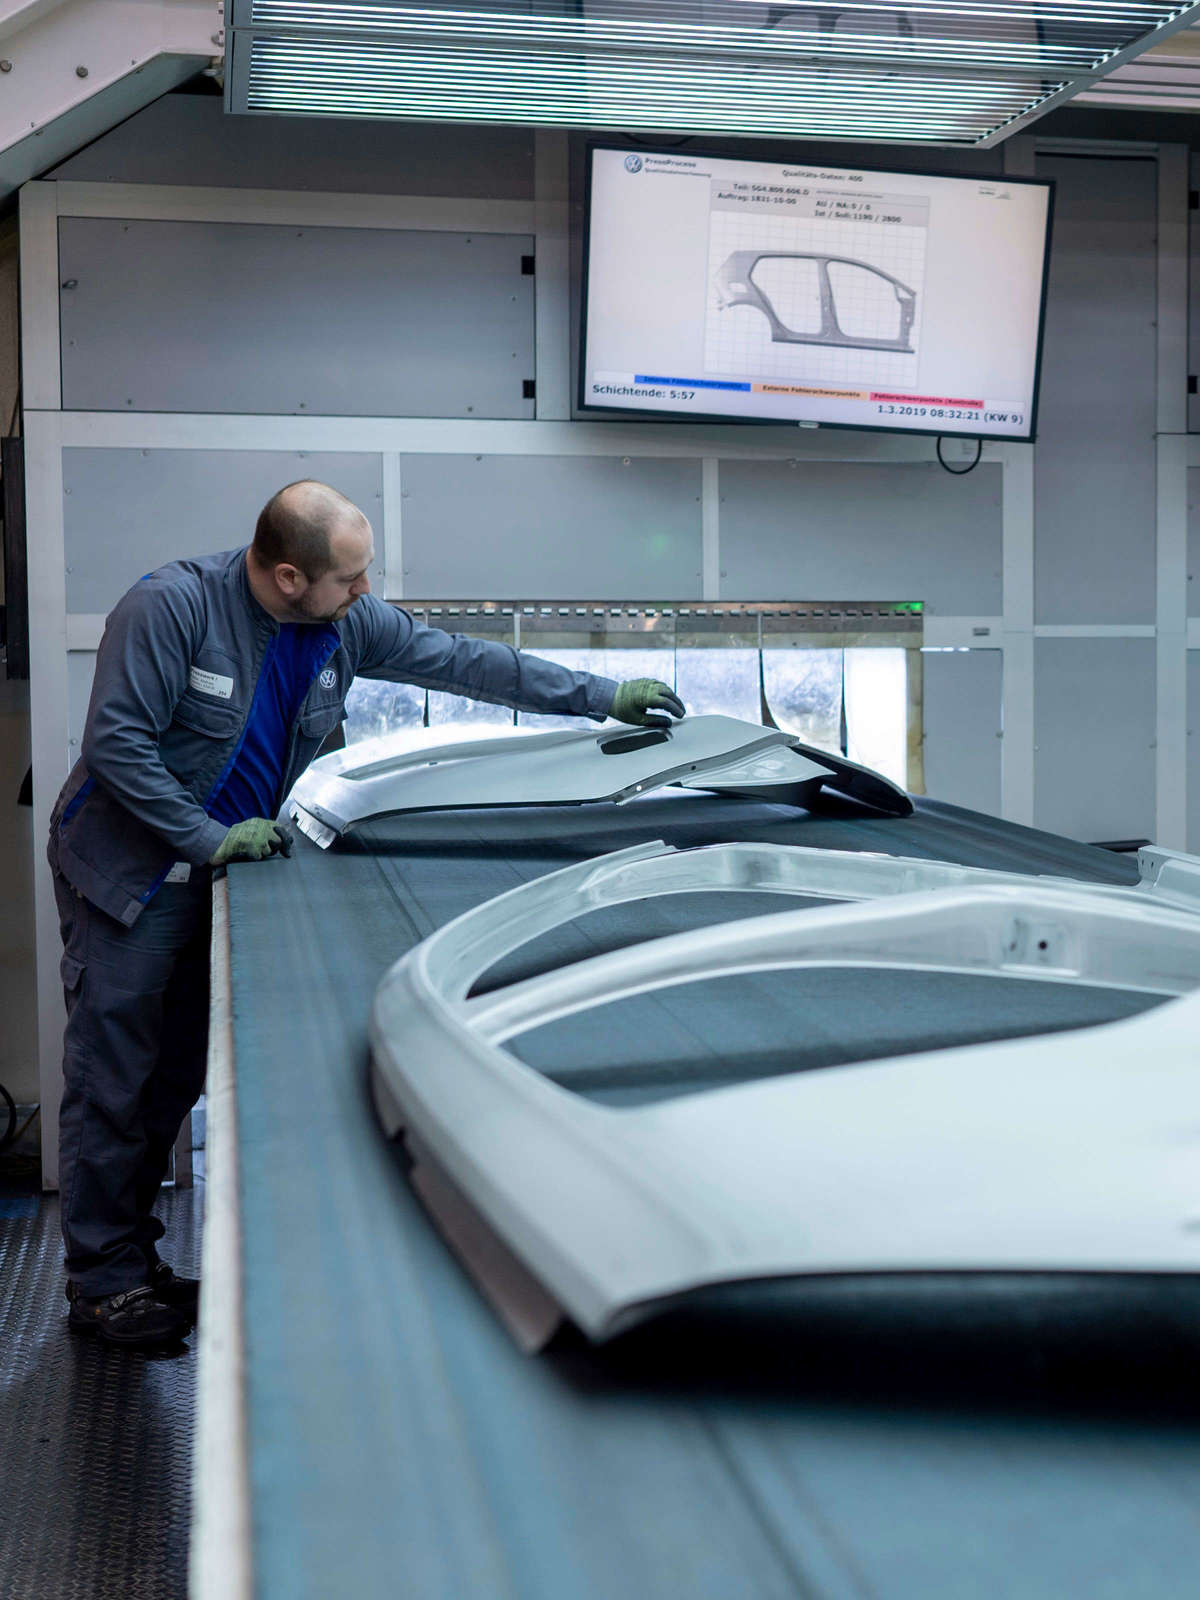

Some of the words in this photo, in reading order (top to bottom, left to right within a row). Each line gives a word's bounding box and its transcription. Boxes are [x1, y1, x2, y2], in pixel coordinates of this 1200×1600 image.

[593, 384, 666, 398] Schichtende:
[670, 390, 695, 400] 5:57
[878, 405, 926, 417] 1.3.2019
[930, 409, 979, 420] 08:32:21
[984, 413, 1007, 423] (KW
[1011, 414, 1024, 425] 9)
